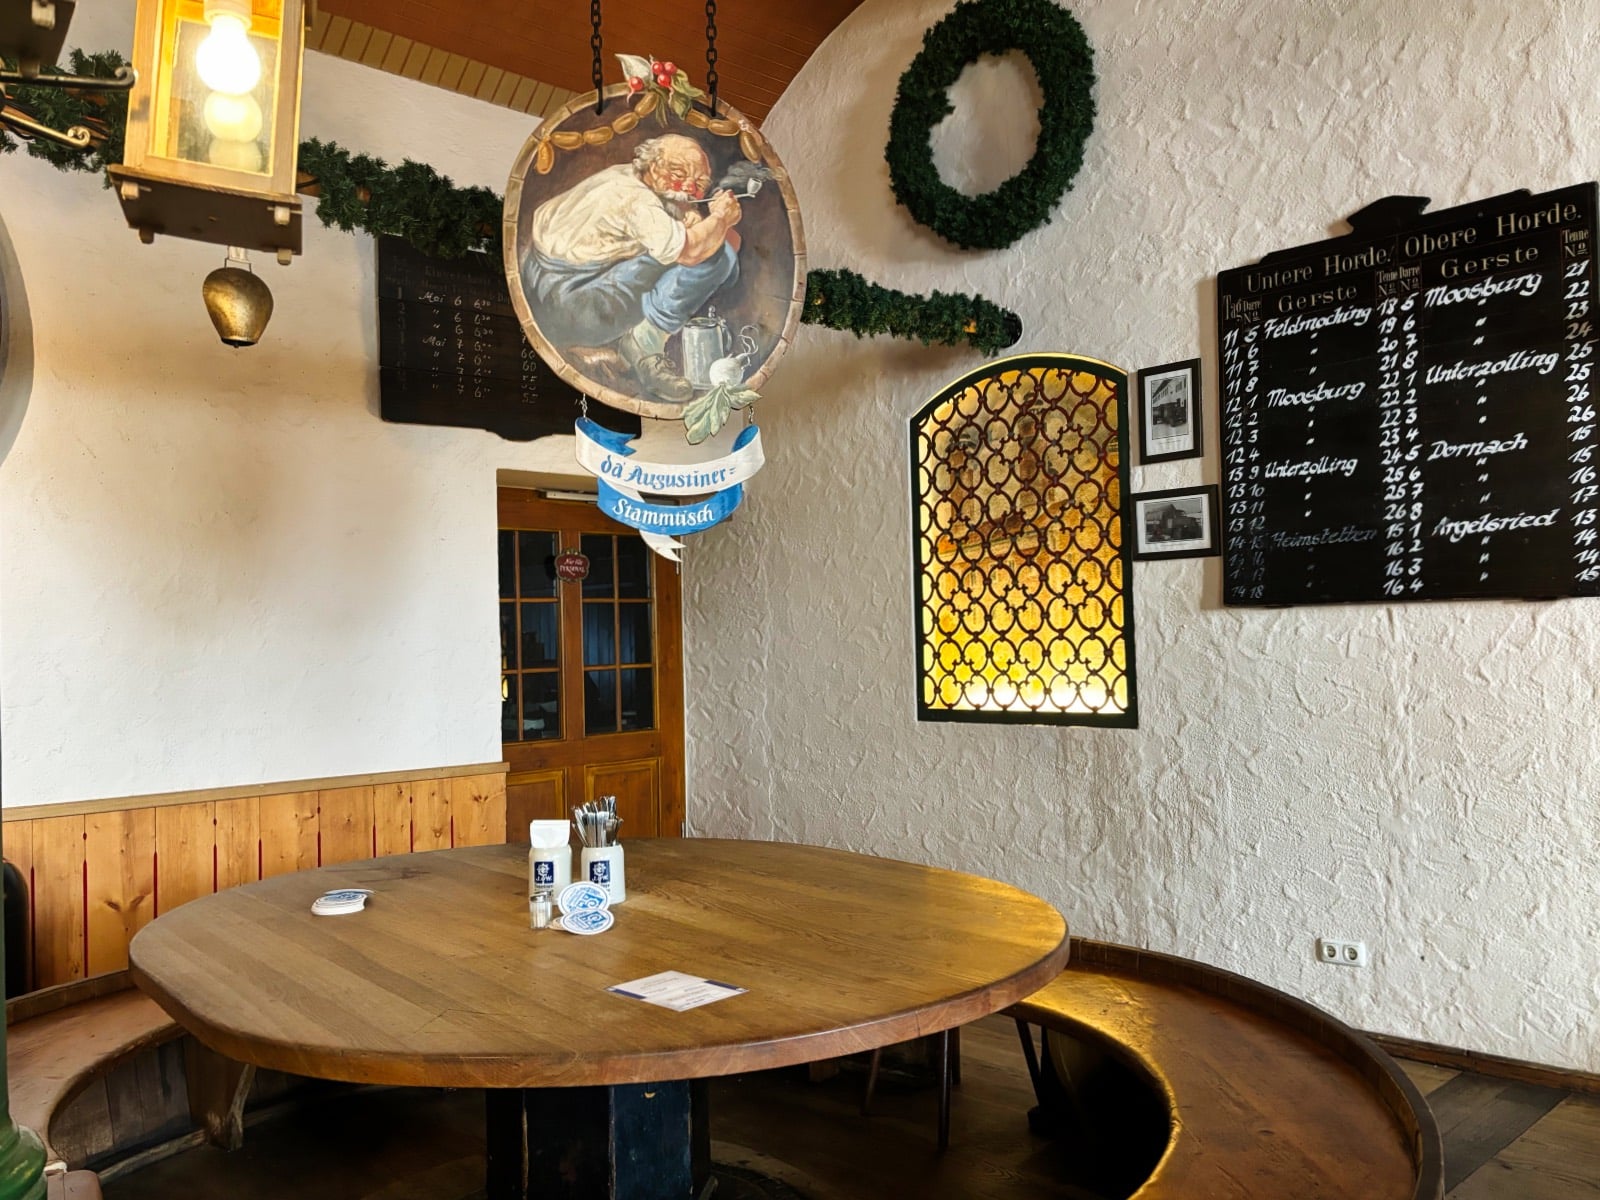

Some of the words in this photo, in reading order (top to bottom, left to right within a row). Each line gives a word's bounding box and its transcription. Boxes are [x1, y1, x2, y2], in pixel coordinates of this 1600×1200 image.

[1405, 227, 1477, 257] Obere
[1496, 202, 1582, 237] Horde.
[1563, 228, 1589, 243] Tenne
[1248, 265, 1312, 292] Untere
[1441, 247, 1539, 278] Gerste
[454, 296, 462, 306] 6
[1278, 286, 1357, 313] Gerste
[1400, 291, 1419, 311] 5
[1424, 273, 1542, 308] Moosburg
[1563, 259, 1590, 280] 21
[454, 313, 462, 323] 6
[1224, 328, 1239, 350] 11
[1244, 325, 1260, 343] 5
[1264, 305, 1372, 339] Feldmoching
[1377, 297, 1398, 316] 18
[1402, 313, 1415, 331] 6
[1563, 280, 1590, 300] 22
[1224, 347, 1240, 365] 11
[1247, 343, 1259, 359] 6
[1377, 316, 1398, 334] 19
[1405, 333, 1418, 351] 7
[1563, 300, 1589, 320] 23
[1226, 360, 1243, 380] 11
[1248, 360, 1260, 376] 7
[1377, 336, 1398, 353] 20
[1402, 350, 1419, 369] 8
[1564, 321, 1593, 340] 24
[1405, 370, 1418, 387] 1
[1425, 349, 1559, 384] Unterzolling
[1564, 339, 1599, 361] 25
[1226, 378, 1241, 396] 11
[1245, 376, 1259, 392] 8
[1378, 353, 1399, 371] 21
[1226, 396, 1242, 414] 12
[1247, 394, 1258, 408] 1
[1266, 381, 1366, 408] Moosburg
[1378, 370, 1400, 390] 22
[1403, 388, 1418, 405] 2
[1564, 362, 1594, 382] 25
[1225, 412, 1242, 429] 12
[1247, 412, 1258, 425] 2
[1379, 389, 1400, 408] 22
[1405, 407, 1418, 424] 3
[1565, 383, 1590, 403] 26
[1225, 429, 1243, 445] 12
[1248, 429, 1259, 443] 3
[1379, 408, 1401, 429] 22
[1405, 427, 1420, 443] 4
[1567, 404, 1596, 423] 26
[1226, 447, 1245, 464] 12
[1249, 448, 1260, 461] 4
[1379, 427, 1400, 447] 23
[1405, 444, 1422, 461] 5
[1427, 432, 1528, 461] Dornach
[1567, 424, 1597, 442] 15
[1228, 466, 1244, 481] 13
[1249, 466, 1259, 479] 9
[1265, 456, 1358, 478] Unterzolling
[1381, 447, 1403, 465] 24
[1408, 466, 1421, 481] 6
[1567, 444, 1598, 463] 15
[1227, 483, 1247, 498] 13
[1248, 483, 1265, 497] 10
[1382, 465, 1407, 483] 25
[1229, 500, 1247, 514] 13
[1249, 501, 1264, 514] 11
[1384, 482, 1408, 501] 25
[1411, 482, 1424, 500] 7
[1567, 465, 1596, 484] 16
[612, 498, 716, 526] Stammtisch
[1229, 518, 1245, 532] 13
[1248, 515, 1265, 529] 12
[1382, 503, 1407, 520] 26
[1410, 502, 1423, 521] 8
[1569, 484, 1599, 504] 17
[1385, 522, 1405, 539] 15
[1408, 539, 1424, 553] 2
[1573, 528, 1598, 546] 14
[1409, 522, 1422, 539] 1
[1570, 508, 1598, 526] 13
[1384, 540, 1404, 557] 16
[1408, 558, 1424, 576] 3
[1573, 548, 1600, 564] 14
[1384, 559, 1404, 576] 16
[1409, 577, 1424, 593] 4
[1574, 565, 1600, 582] 15
[1383, 578, 1404, 596] 16
